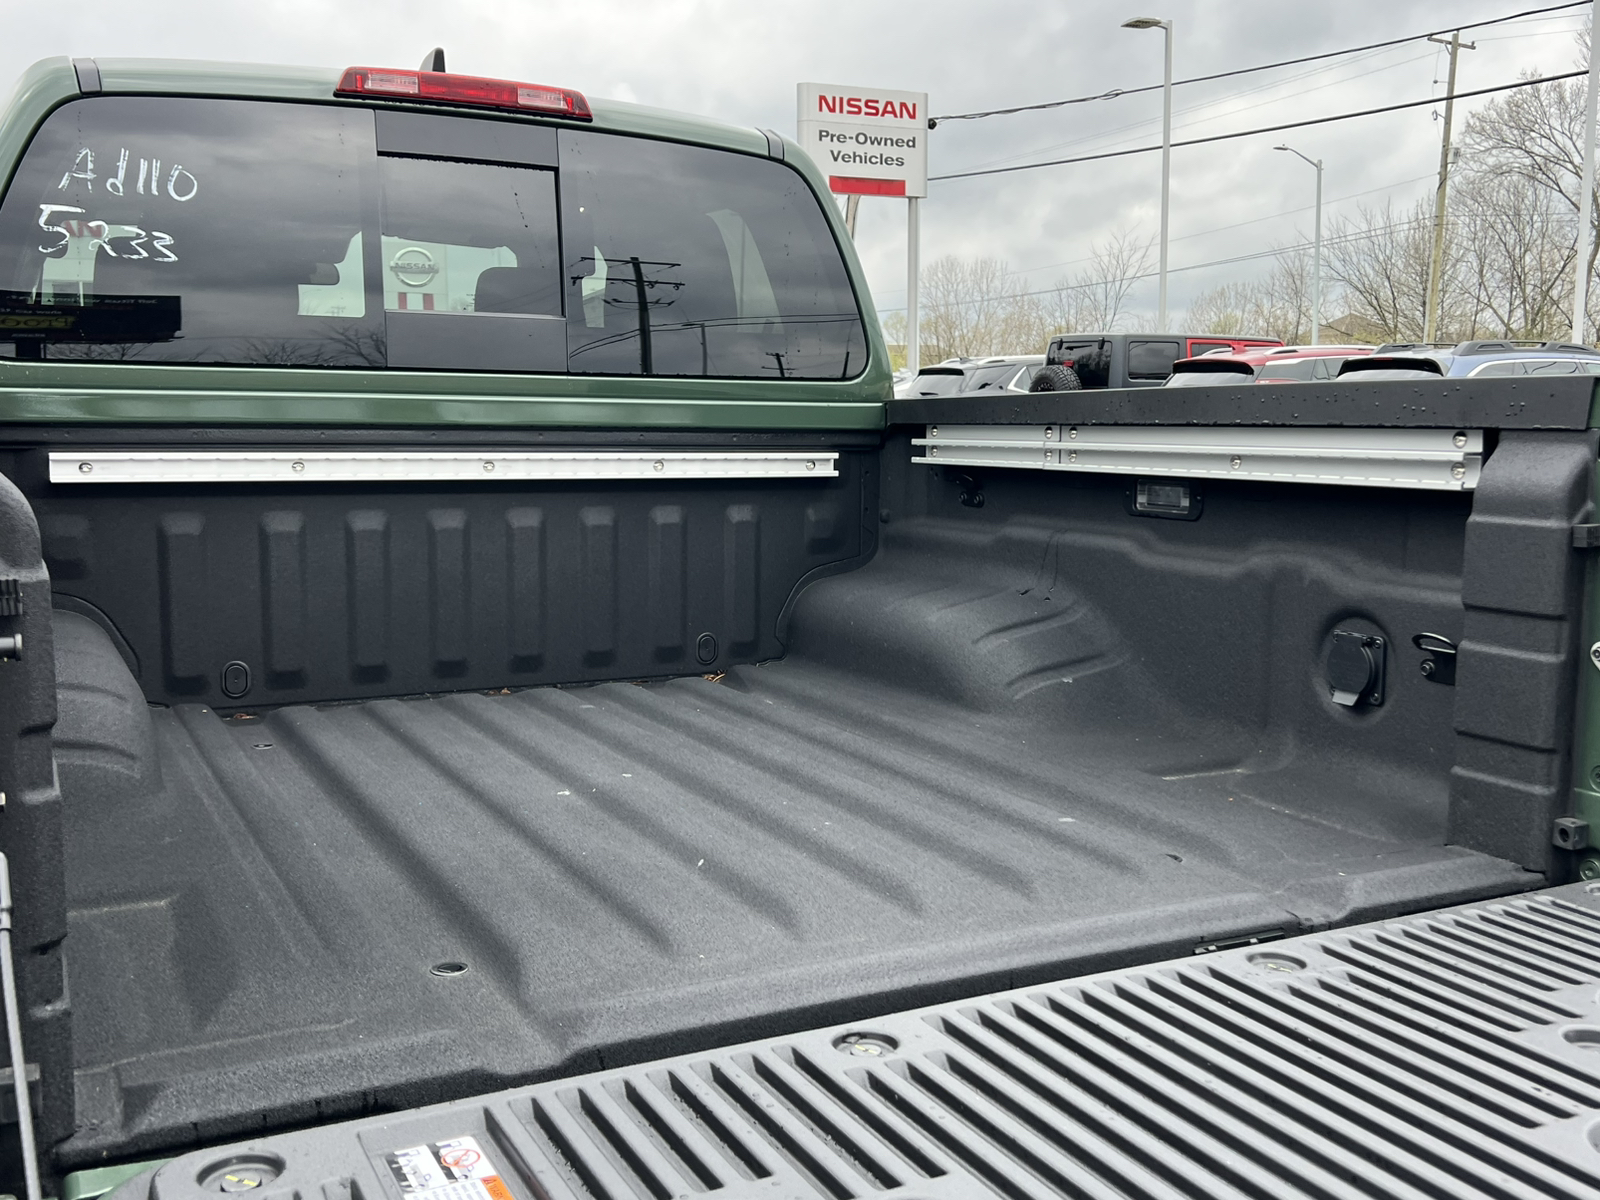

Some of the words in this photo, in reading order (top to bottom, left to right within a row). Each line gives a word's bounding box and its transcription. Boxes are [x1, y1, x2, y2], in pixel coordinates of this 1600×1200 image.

[818, 94, 917, 120] NISSAN
[818, 129, 916, 148] Pre-Owned
[830, 149, 905, 167] Vehicles
[394, 261, 435, 271] NISSAN
